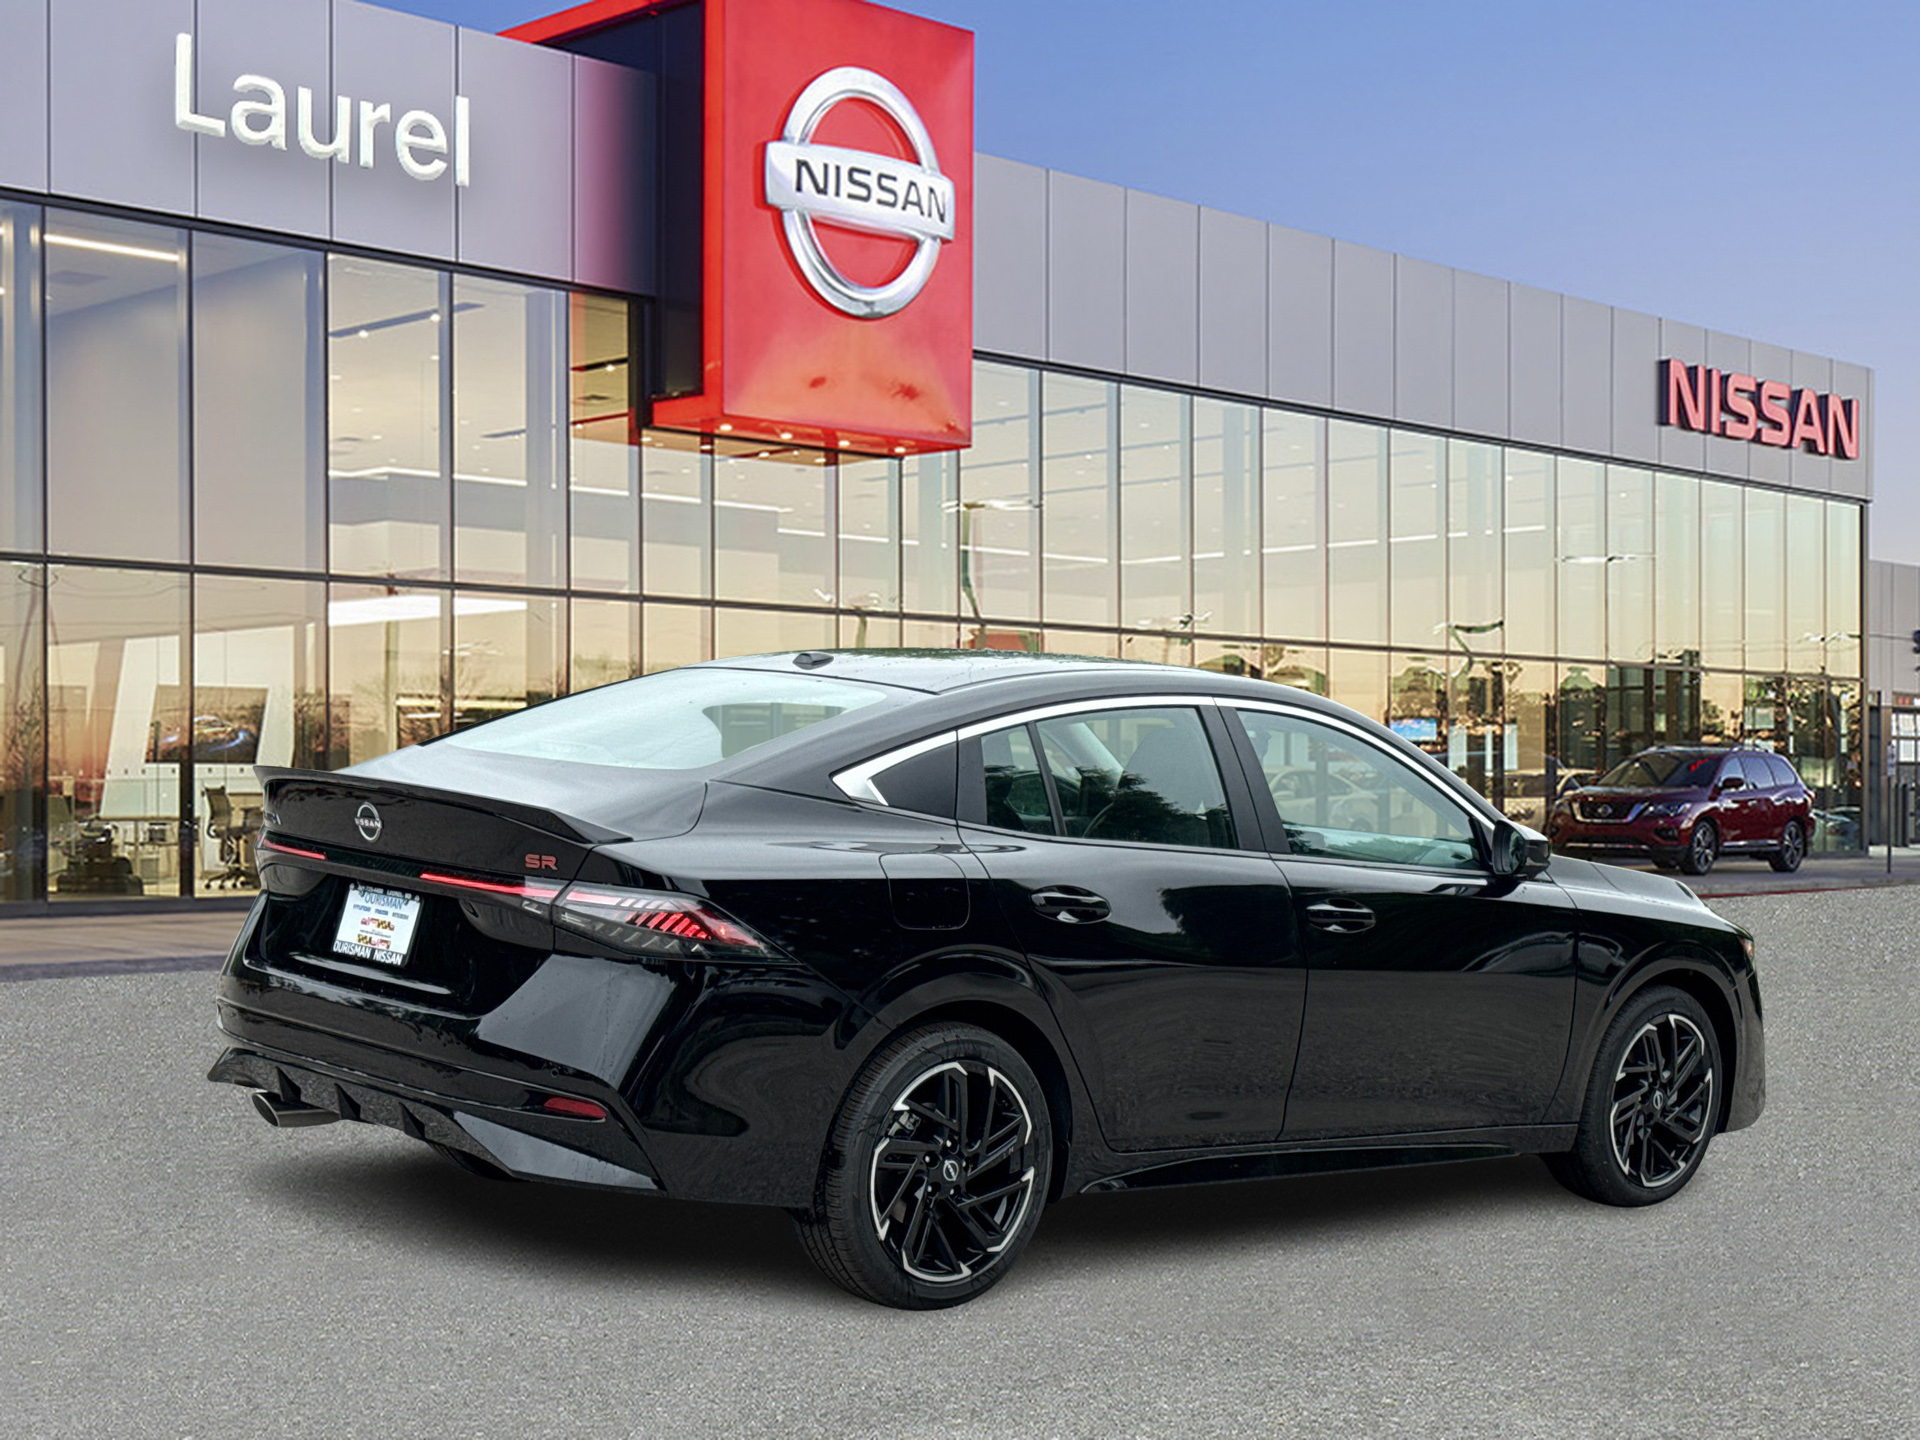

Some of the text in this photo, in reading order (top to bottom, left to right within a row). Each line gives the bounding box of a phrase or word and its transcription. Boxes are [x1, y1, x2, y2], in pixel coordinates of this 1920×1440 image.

[175, 33, 470, 187] Laurel
[795, 158, 947, 223] NISSAN
[1666, 358, 1860, 460] NISSAN
[525, 853, 559, 870] SR
[364, 892, 403, 910] OURISMAN
[333, 941, 403, 965] OURISMAN NISSAN
